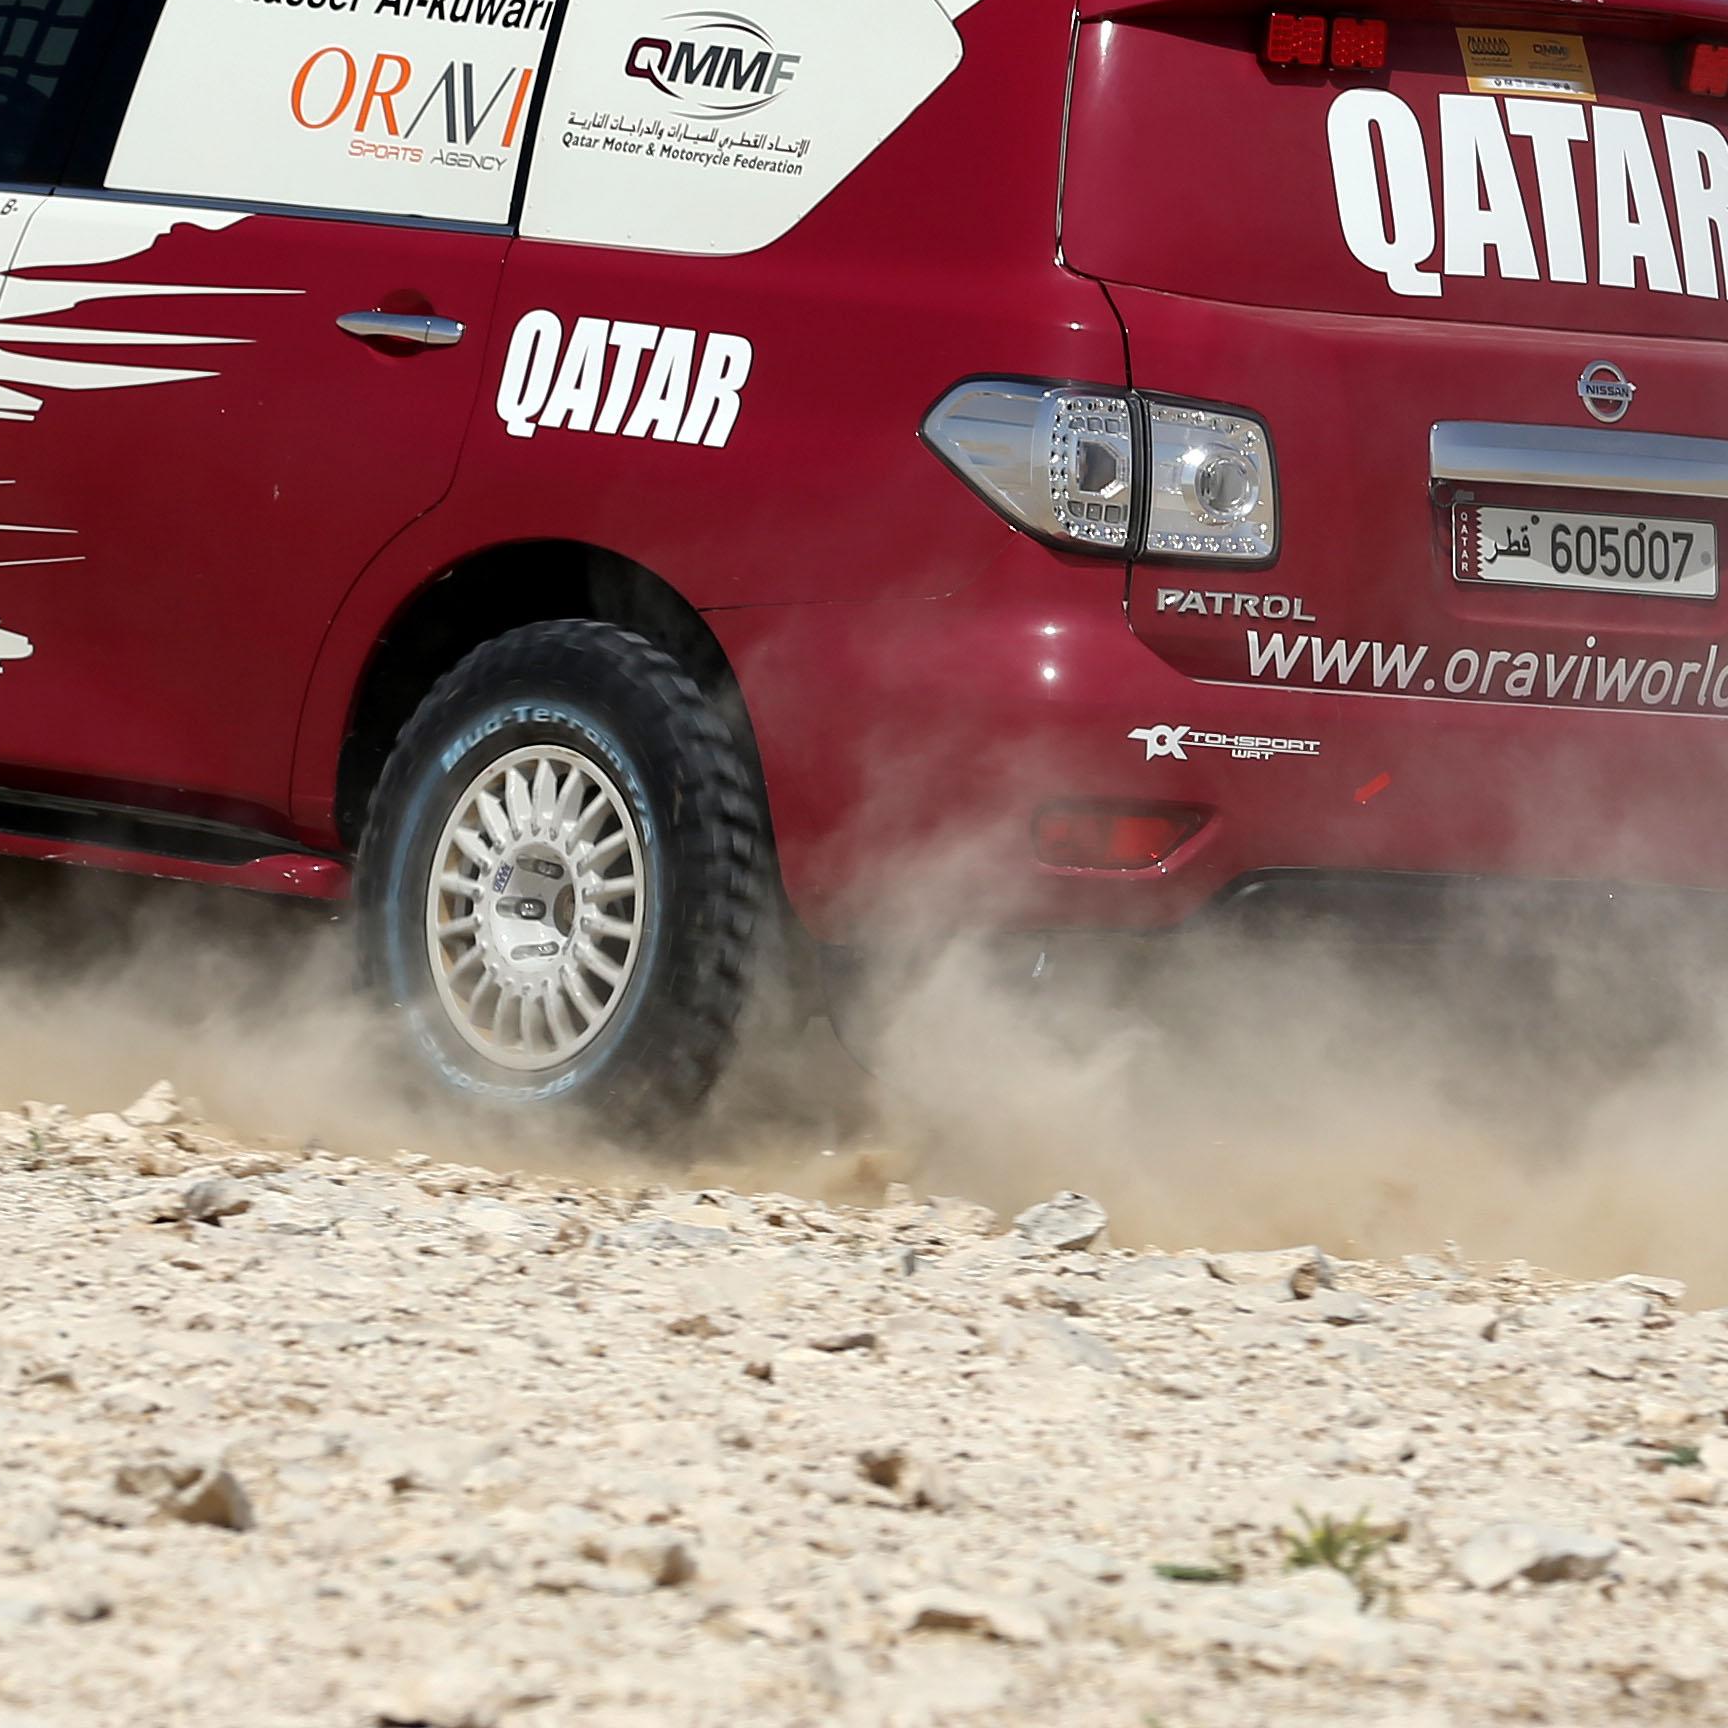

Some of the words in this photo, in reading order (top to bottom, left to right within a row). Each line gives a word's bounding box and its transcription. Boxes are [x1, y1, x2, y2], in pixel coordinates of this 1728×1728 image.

[625, 37, 802, 98] QMMF
[291, 46, 533, 148] ORAVI
[348, 139, 423, 163] SPORTS
[430, 148, 507, 171] AGENCY
[562, 132, 599, 148] Qatar
[603, 136, 642, 154] Motor
[645, 143, 655, 156] &
[659, 144, 730, 168] Motorcycle
[733, 153, 803, 175] Federation
[496, 308, 753, 448] QATAR
[1585, 384, 1629, 398] NISSAN
[1460, 512, 1469, 572] QATAR
[1484, 526, 1532, 563] قطر
[1551, 523, 1694, 583] 605007
[1156, 588, 1316, 622] PATROL
